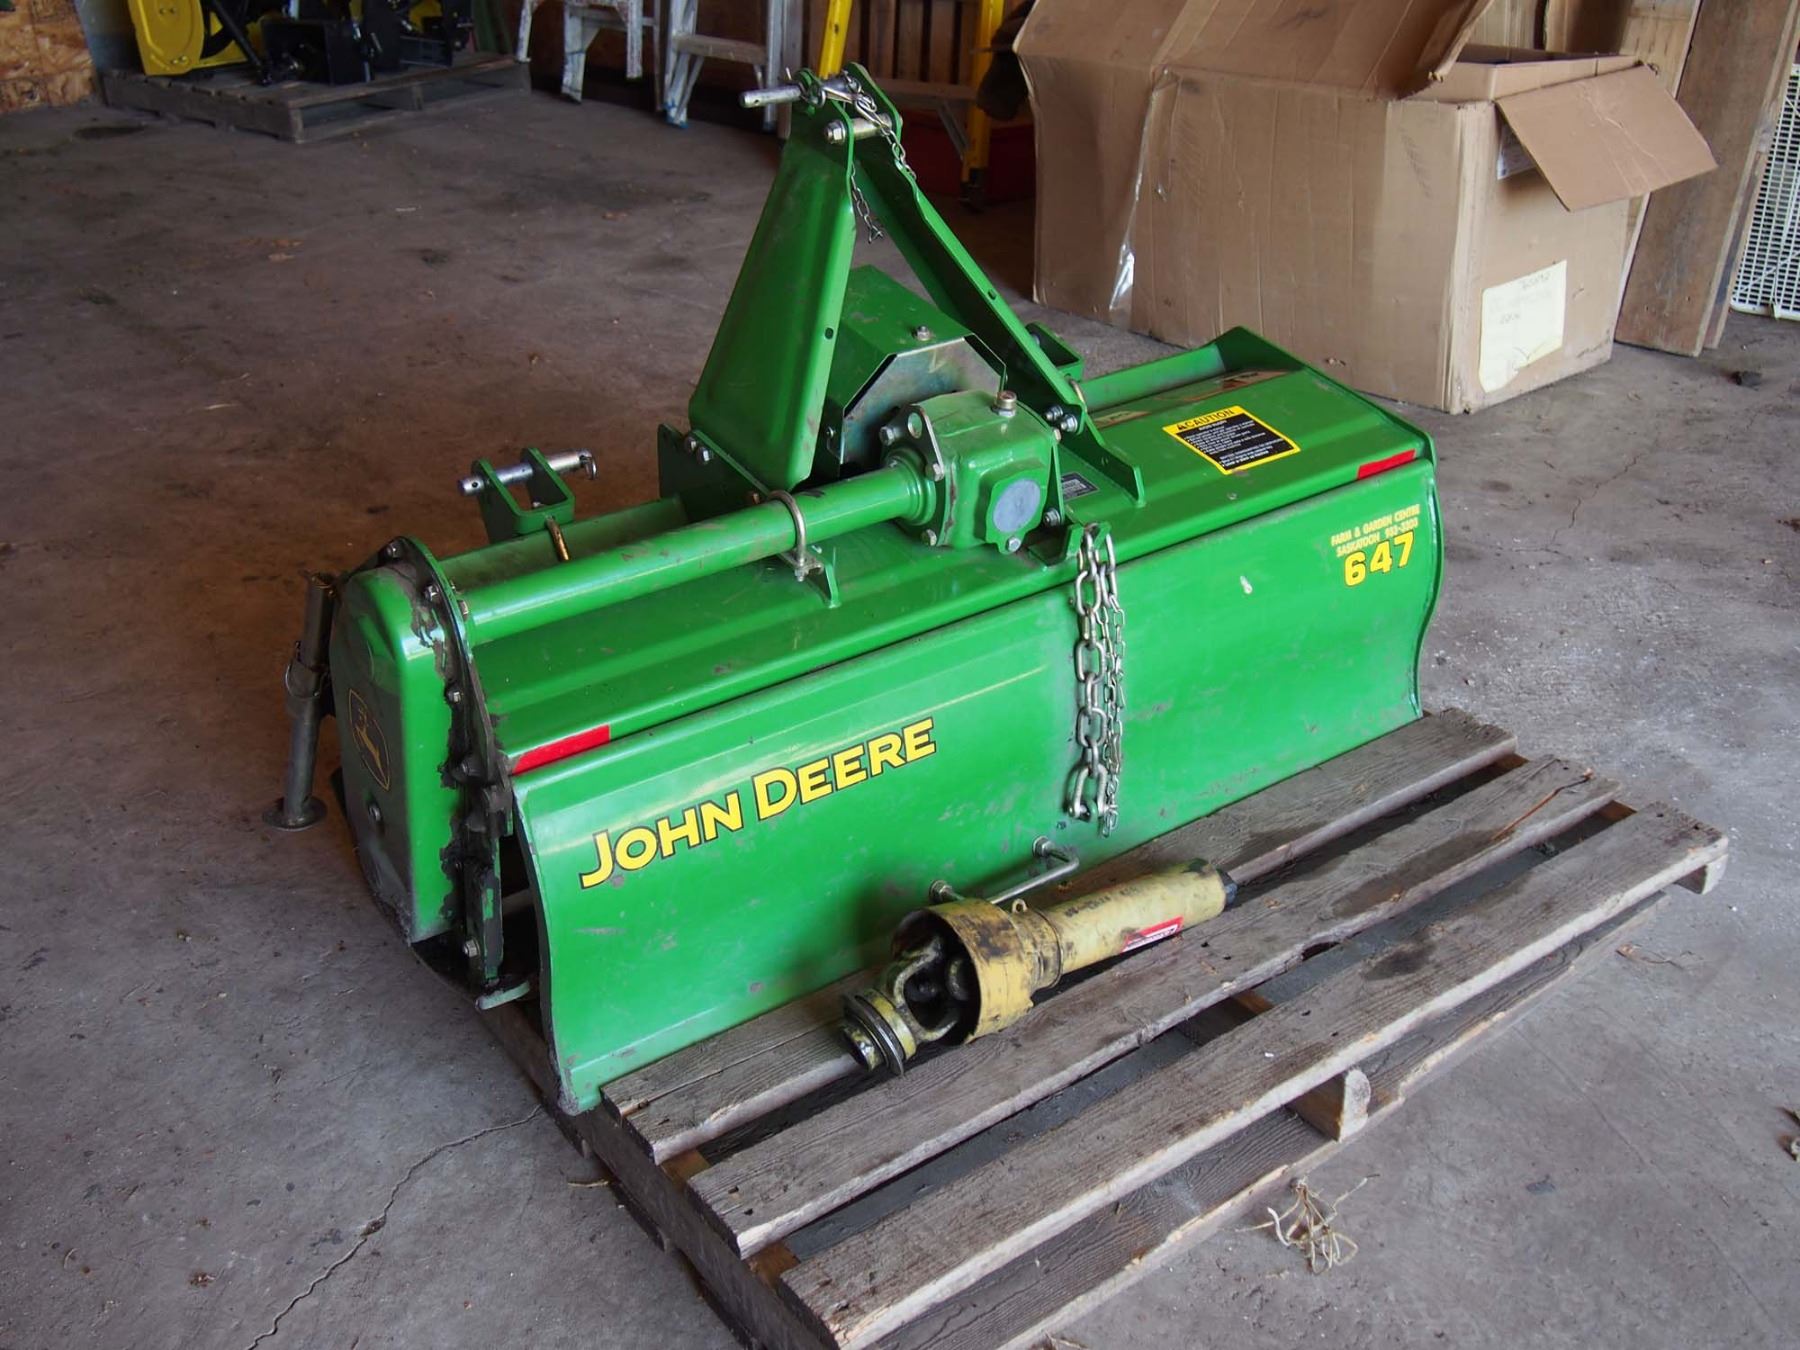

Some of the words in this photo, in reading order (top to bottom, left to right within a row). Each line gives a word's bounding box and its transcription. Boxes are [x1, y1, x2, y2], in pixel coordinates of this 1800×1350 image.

[1181, 408, 1235, 430] CAUTION
[1344, 529, 1414, 587] 647
[579, 789, 744, 890] JOHN
[752, 716, 937, 821] DEERE
